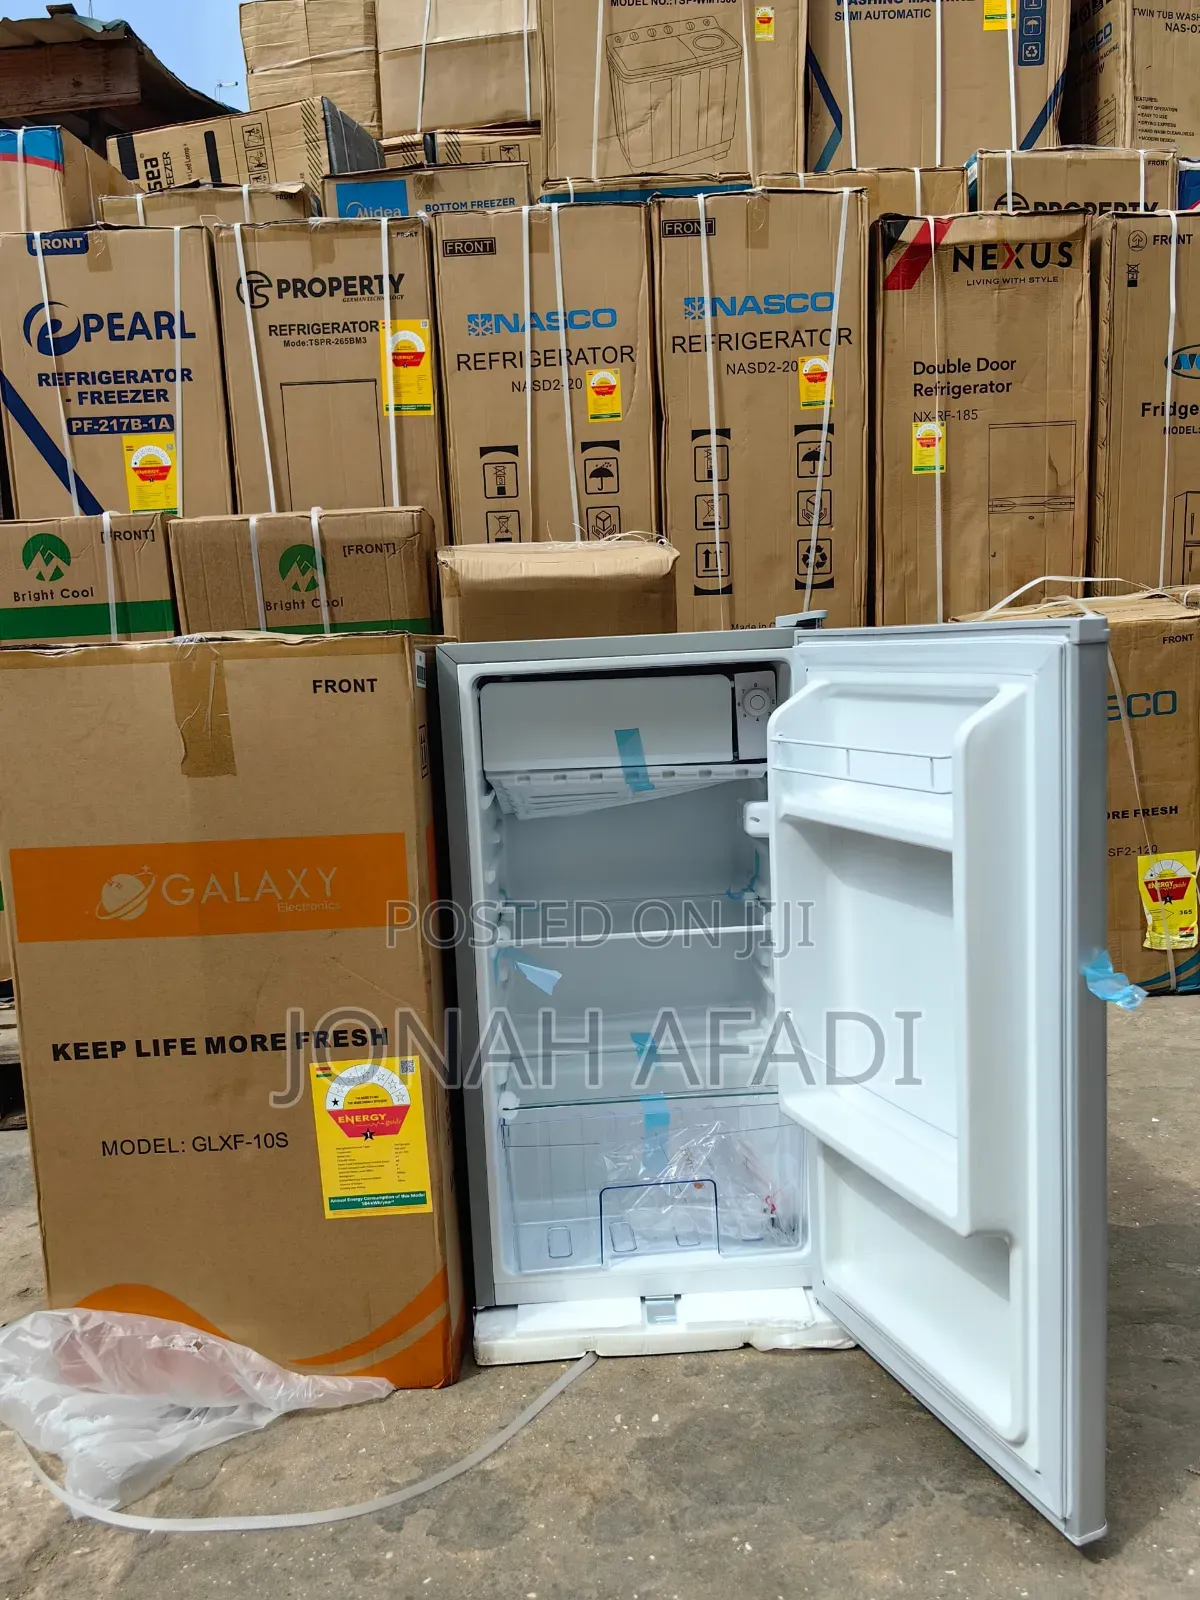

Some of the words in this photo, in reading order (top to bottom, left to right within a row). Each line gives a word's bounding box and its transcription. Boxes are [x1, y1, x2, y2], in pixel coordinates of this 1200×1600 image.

[834, 11, 861, 21] SMI
[864, 8, 932, 20] AUTOMATIC
[1133, 7, 1154, 18] TWIN
[1157, 10, 1173, 20] TUB
[162, 151, 176, 189] EEZER
[357, 206, 401, 218] Midea
[425, 201, 468, 213] BOTTOM
[470, 197, 516, 209] FREEZER
[665, 221, 712, 235] FRONT
[446, 240, 492, 254] FRONT
[952, 241, 1073, 273] NEXUS
[276, 273, 405, 299] PROPERTY
[966, 278, 999, 287] LIVING
[1001, 276, 1026, 285] WITH
[1028, 275, 1059, 284] STYLE
[711, 291, 835, 317] NASCO
[82, 310, 197, 343] PEARL
[269, 320, 380, 337] REFRIGERATOR
[494, 308, 617, 334] NASCO
[672, 327, 853, 354] REFRIGERATOR
[457, 345, 636, 371] REFRIGERATOR
[913, 358, 971, 375] Double
[976, 357, 1016, 373] Door
[37, 367, 193, 387] REFRIGERATOR
[77, 388, 170, 405] FREEZER
[913, 379, 1012, 399] Refrigerator
[913, 409, 978, 423] NX-RF-185
[71, 417, 171, 433] PF-217B-1A
[342, 542, 396, 557] [FRONT]
[13, 589, 54, 602] Bright
[60, 586, 94, 599] Cool
[265, 599, 305, 612] Bright
[1162, 633, 1194, 645] FRONT
[312, 678, 378, 694] FRONT
[1107, 810, 1129, 820] RE
[1133, 805, 1178, 818] FRESH
[161, 866, 338, 906] GALAXY
[277, 900, 341, 914] Electronics
[52, 1041, 126, 1062] KEEP
[135, 1036, 197, 1058] LIFE
[205, 1032, 287, 1056] MORE
[295, 1027, 389, 1050] FRESH
[337, 1113, 387, 1124] ENERGY
[101, 1137, 186, 1156] MODEL:
[192, 1132, 289, 1153] GLXF-10S
